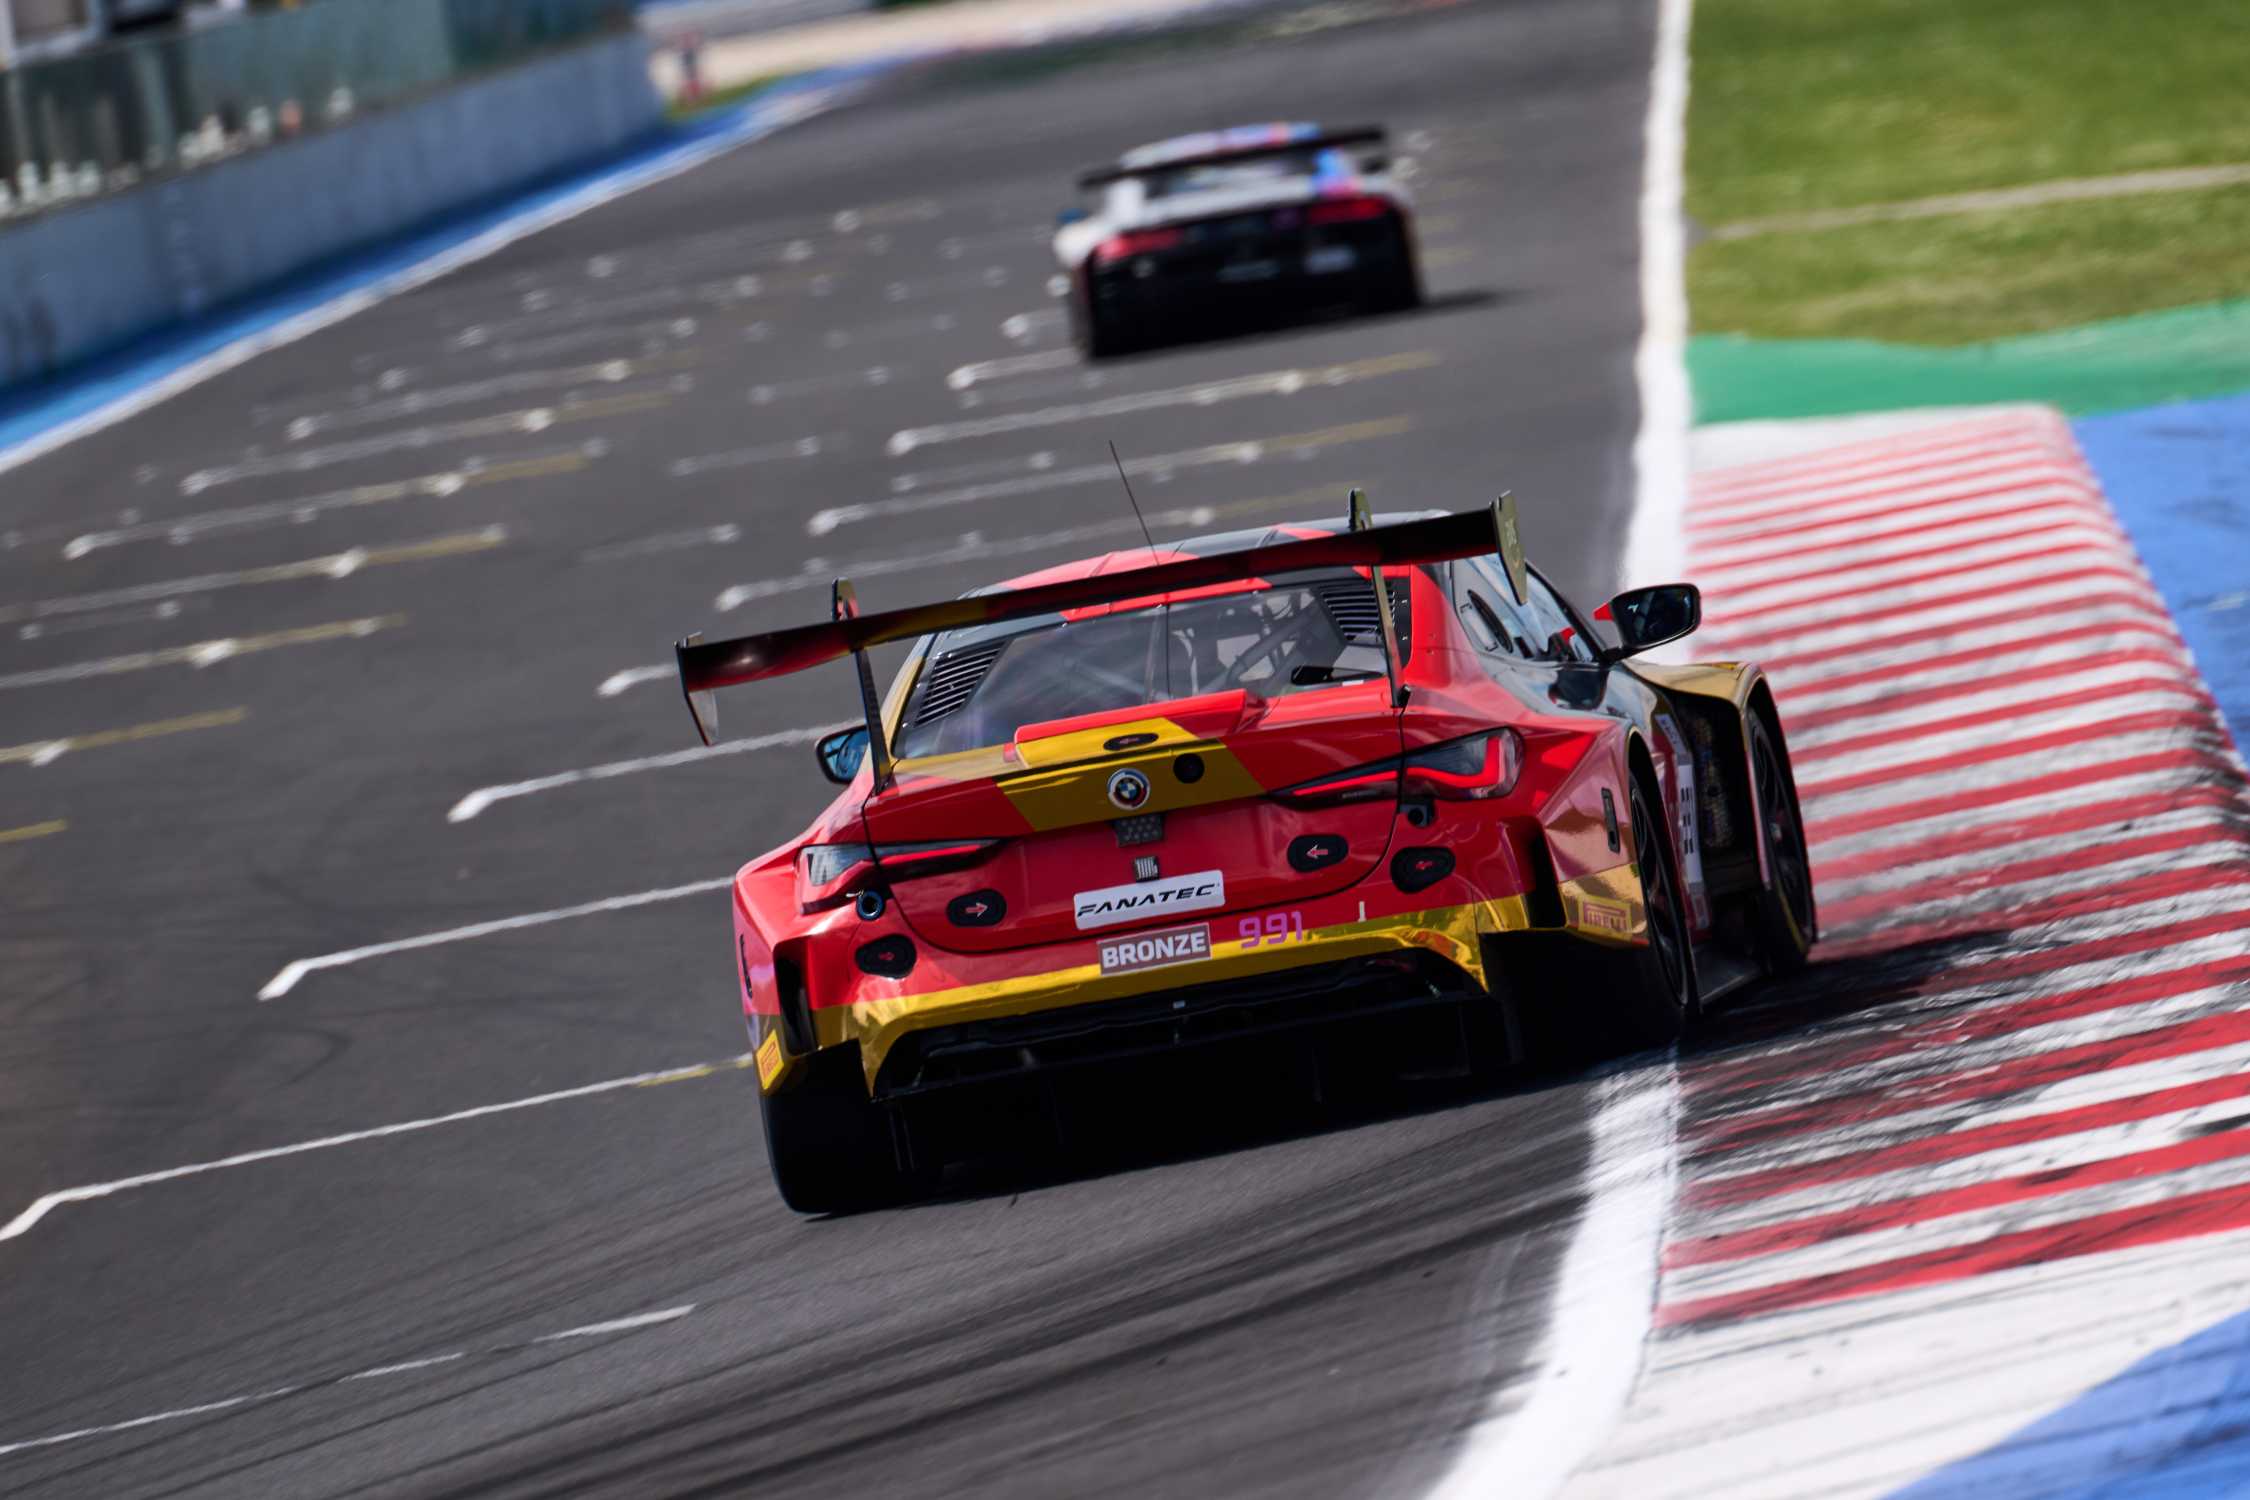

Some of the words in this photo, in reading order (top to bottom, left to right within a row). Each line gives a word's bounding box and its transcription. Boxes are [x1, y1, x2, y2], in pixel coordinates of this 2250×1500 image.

[1077, 884, 1215, 917] FANATEC
[1239, 911, 1303, 949] 991
[1102, 931, 1207, 968] BRONZE
